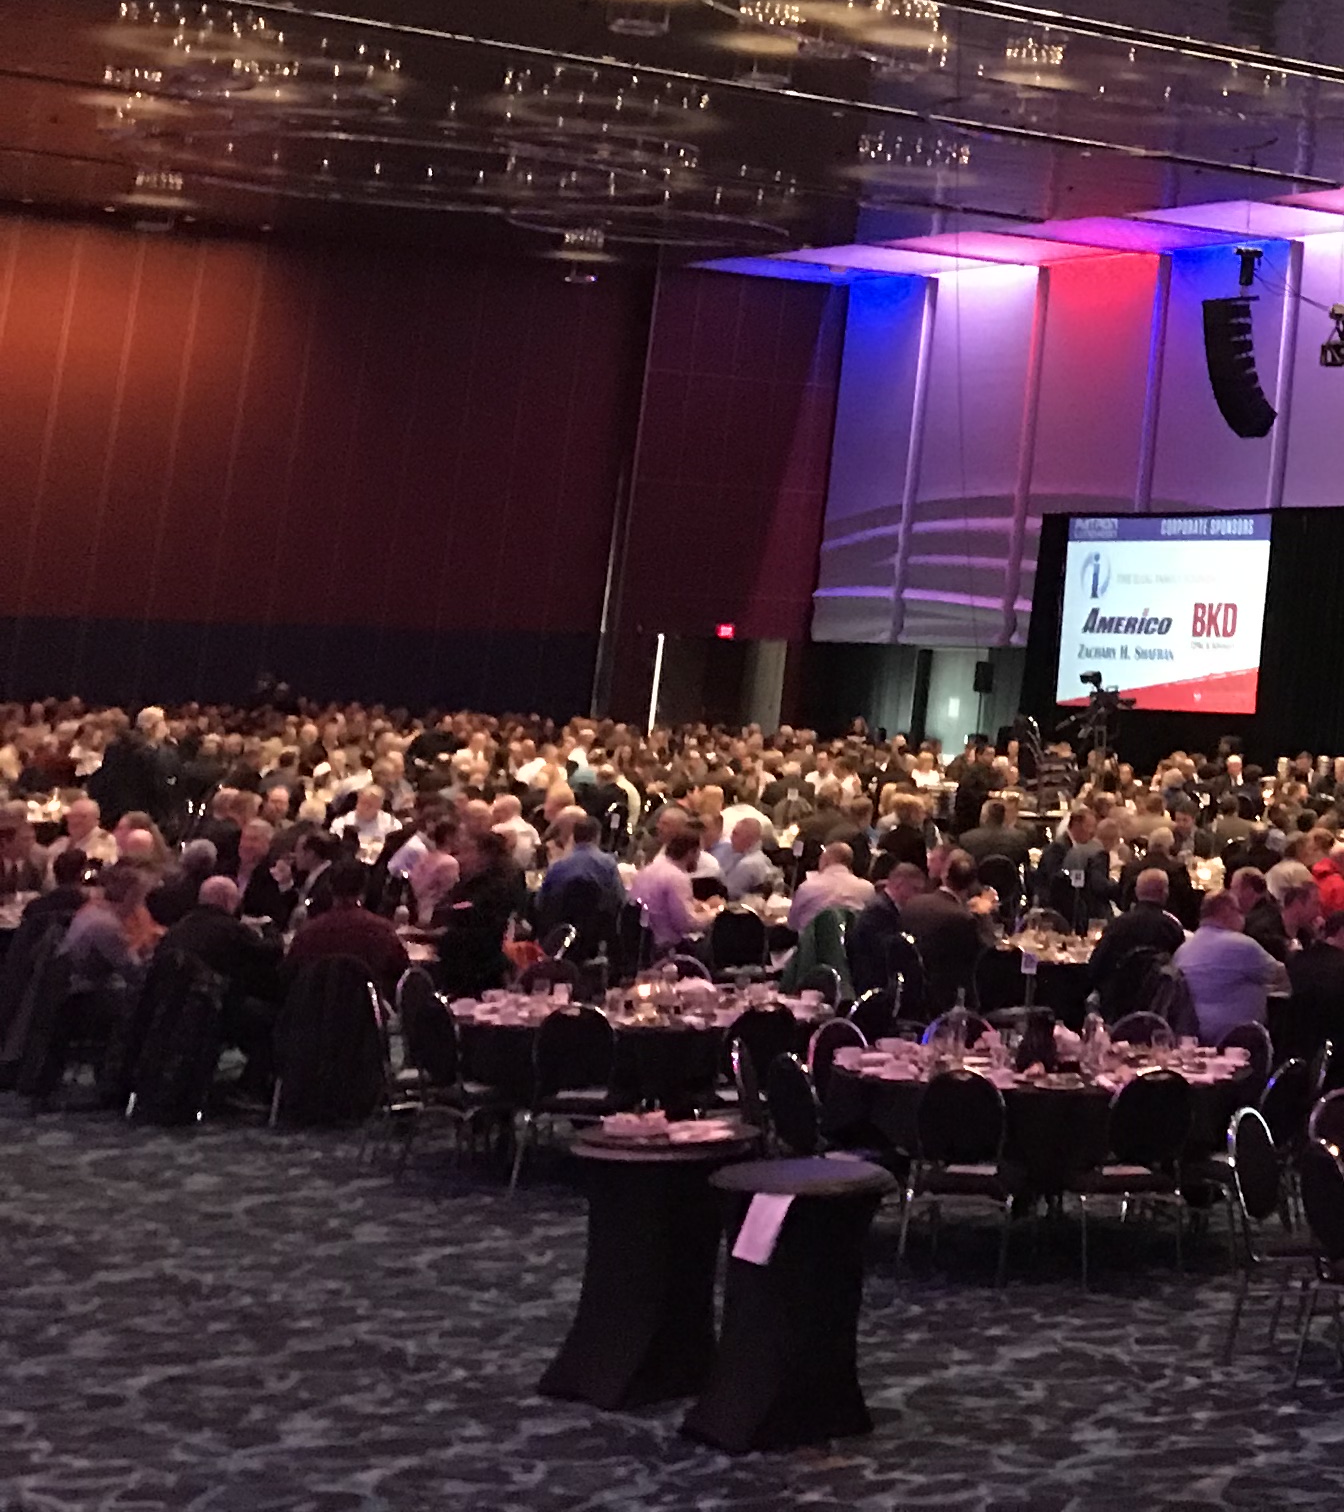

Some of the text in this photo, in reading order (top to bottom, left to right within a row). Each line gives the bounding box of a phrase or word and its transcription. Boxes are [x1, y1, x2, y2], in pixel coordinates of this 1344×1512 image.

[1160, 517, 1255, 536] CORPORATE SPONSORS
[1191, 602, 1238, 638] BKD
